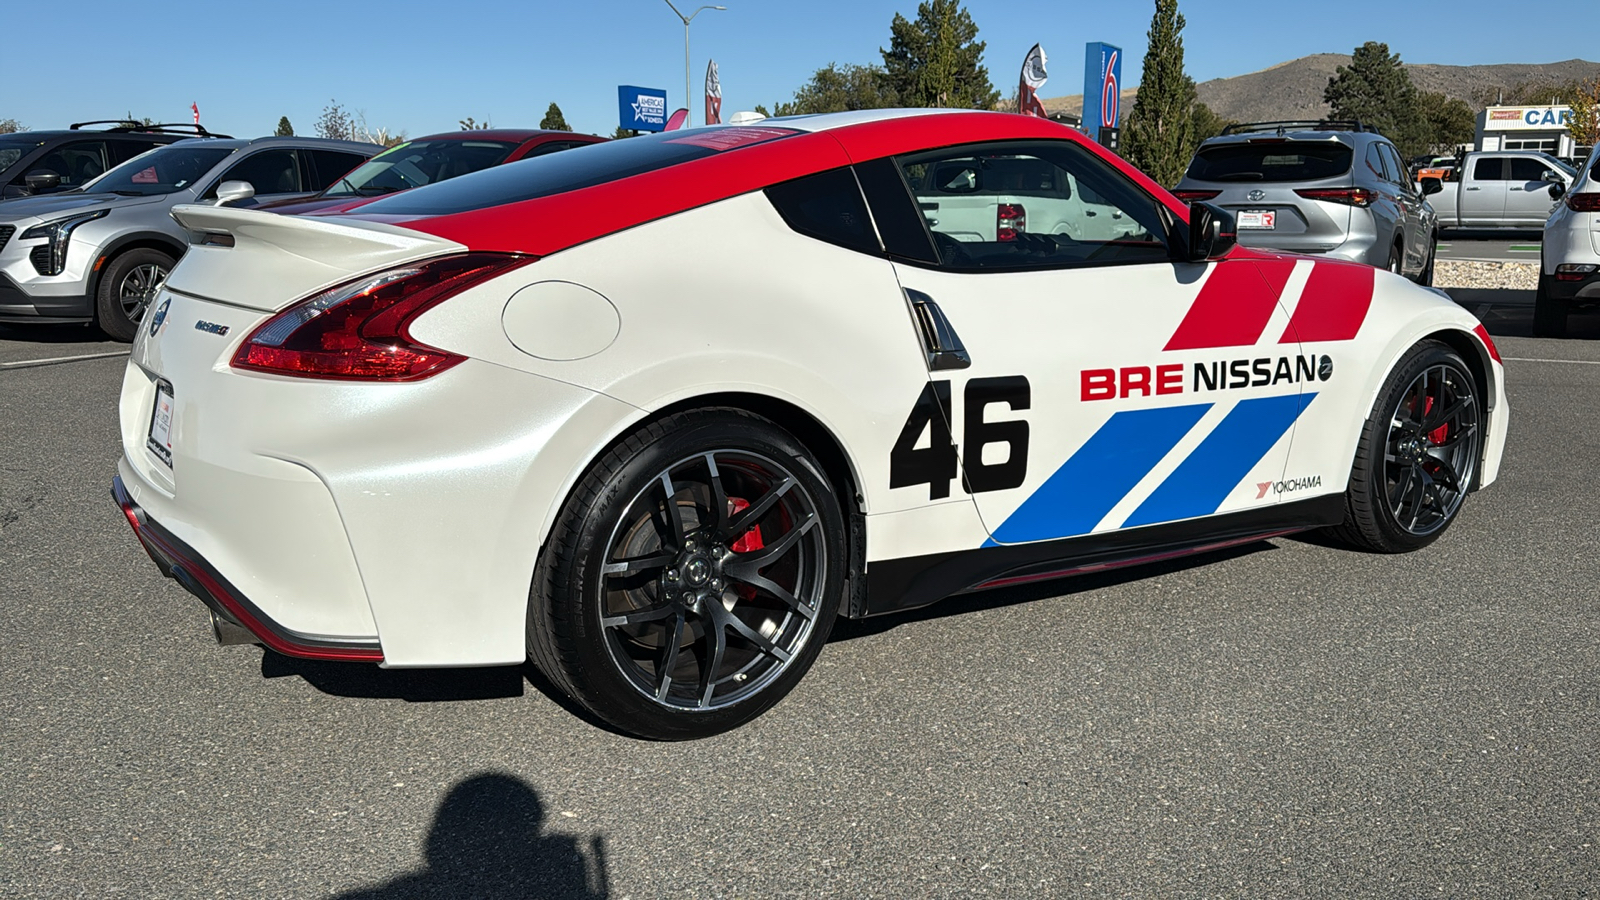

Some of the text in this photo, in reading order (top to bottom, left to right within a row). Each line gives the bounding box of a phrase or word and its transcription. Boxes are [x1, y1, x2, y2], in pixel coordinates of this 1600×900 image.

[1102, 50, 1117, 127] 6
[1080, 354, 1316, 402] BRE NISSAN
[889, 374, 1031, 501] 46
[1272, 475, 1322, 495] YOKOHAMA
